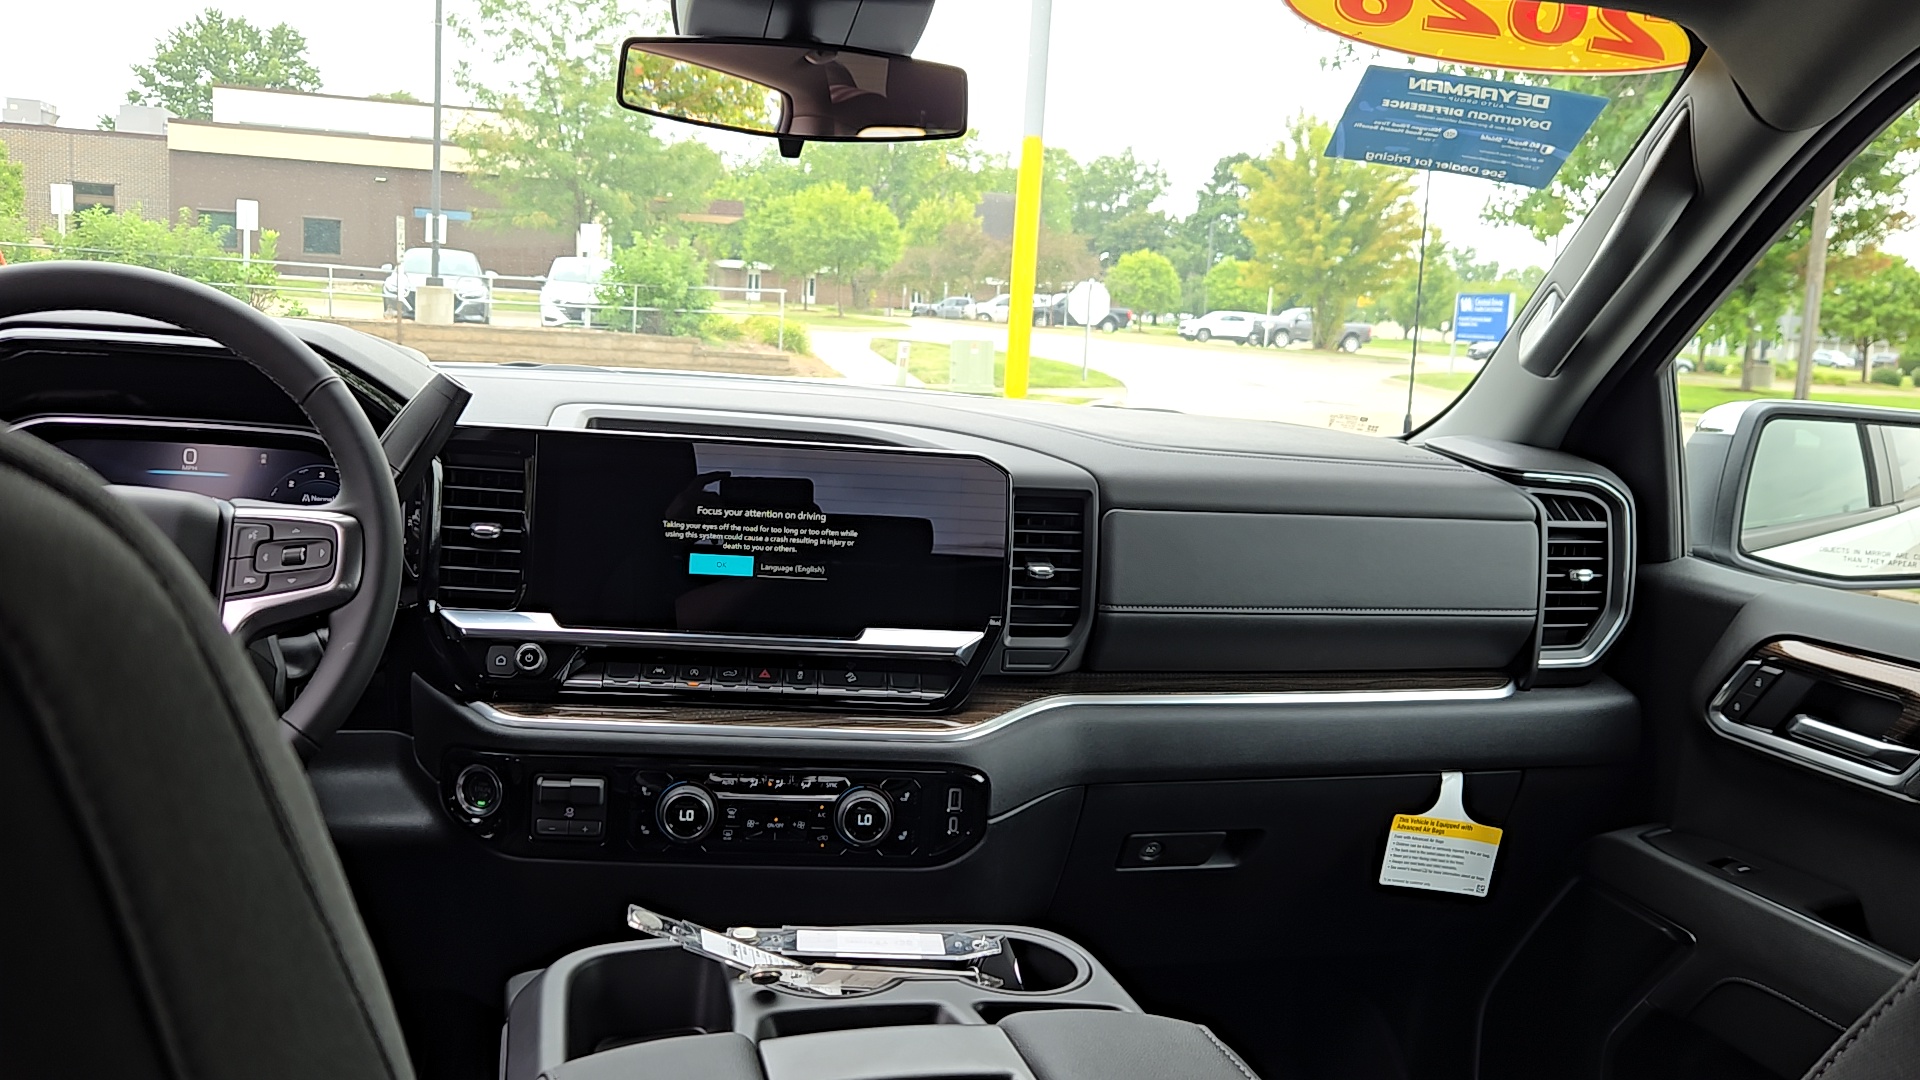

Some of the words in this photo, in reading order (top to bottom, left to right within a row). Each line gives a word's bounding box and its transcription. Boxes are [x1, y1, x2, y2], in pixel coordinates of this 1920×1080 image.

[183, 448, 197, 465] 0
[318, 471, 326, 479] 3
[288, 480, 296, 488] 2
[697, 506, 723, 516] Focus
[723, 509, 743, 518] your
[744, 509, 783, 519] attention
[797, 511, 827, 523] driving
[663, 520, 685, 530] Taking
[685, 523, 701, 531] your
[784, 526, 799, 536] long
[821, 528, 839, 536] often
[840, 530, 859, 538] while
[665, 531, 684, 539] using
[699, 533, 724, 541] system
[789, 537, 819, 546] resulting
[827, 538, 846, 547] injury
[774, 545, 798, 553] others.
[1818, 546, 1850, 554] OBJECTS
[761, 563, 793, 574] Language
[795, 565, 826, 574] (English)
[1888, 560, 1918, 568] APPEAR
[678, 809, 694, 821] LO
[857, 814, 873, 826] LO
[1396, 824, 1423, 832] Advanced
[1410, 817, 1430, 825] Vehicle
[1436, 820, 1461, 829] Equipped
